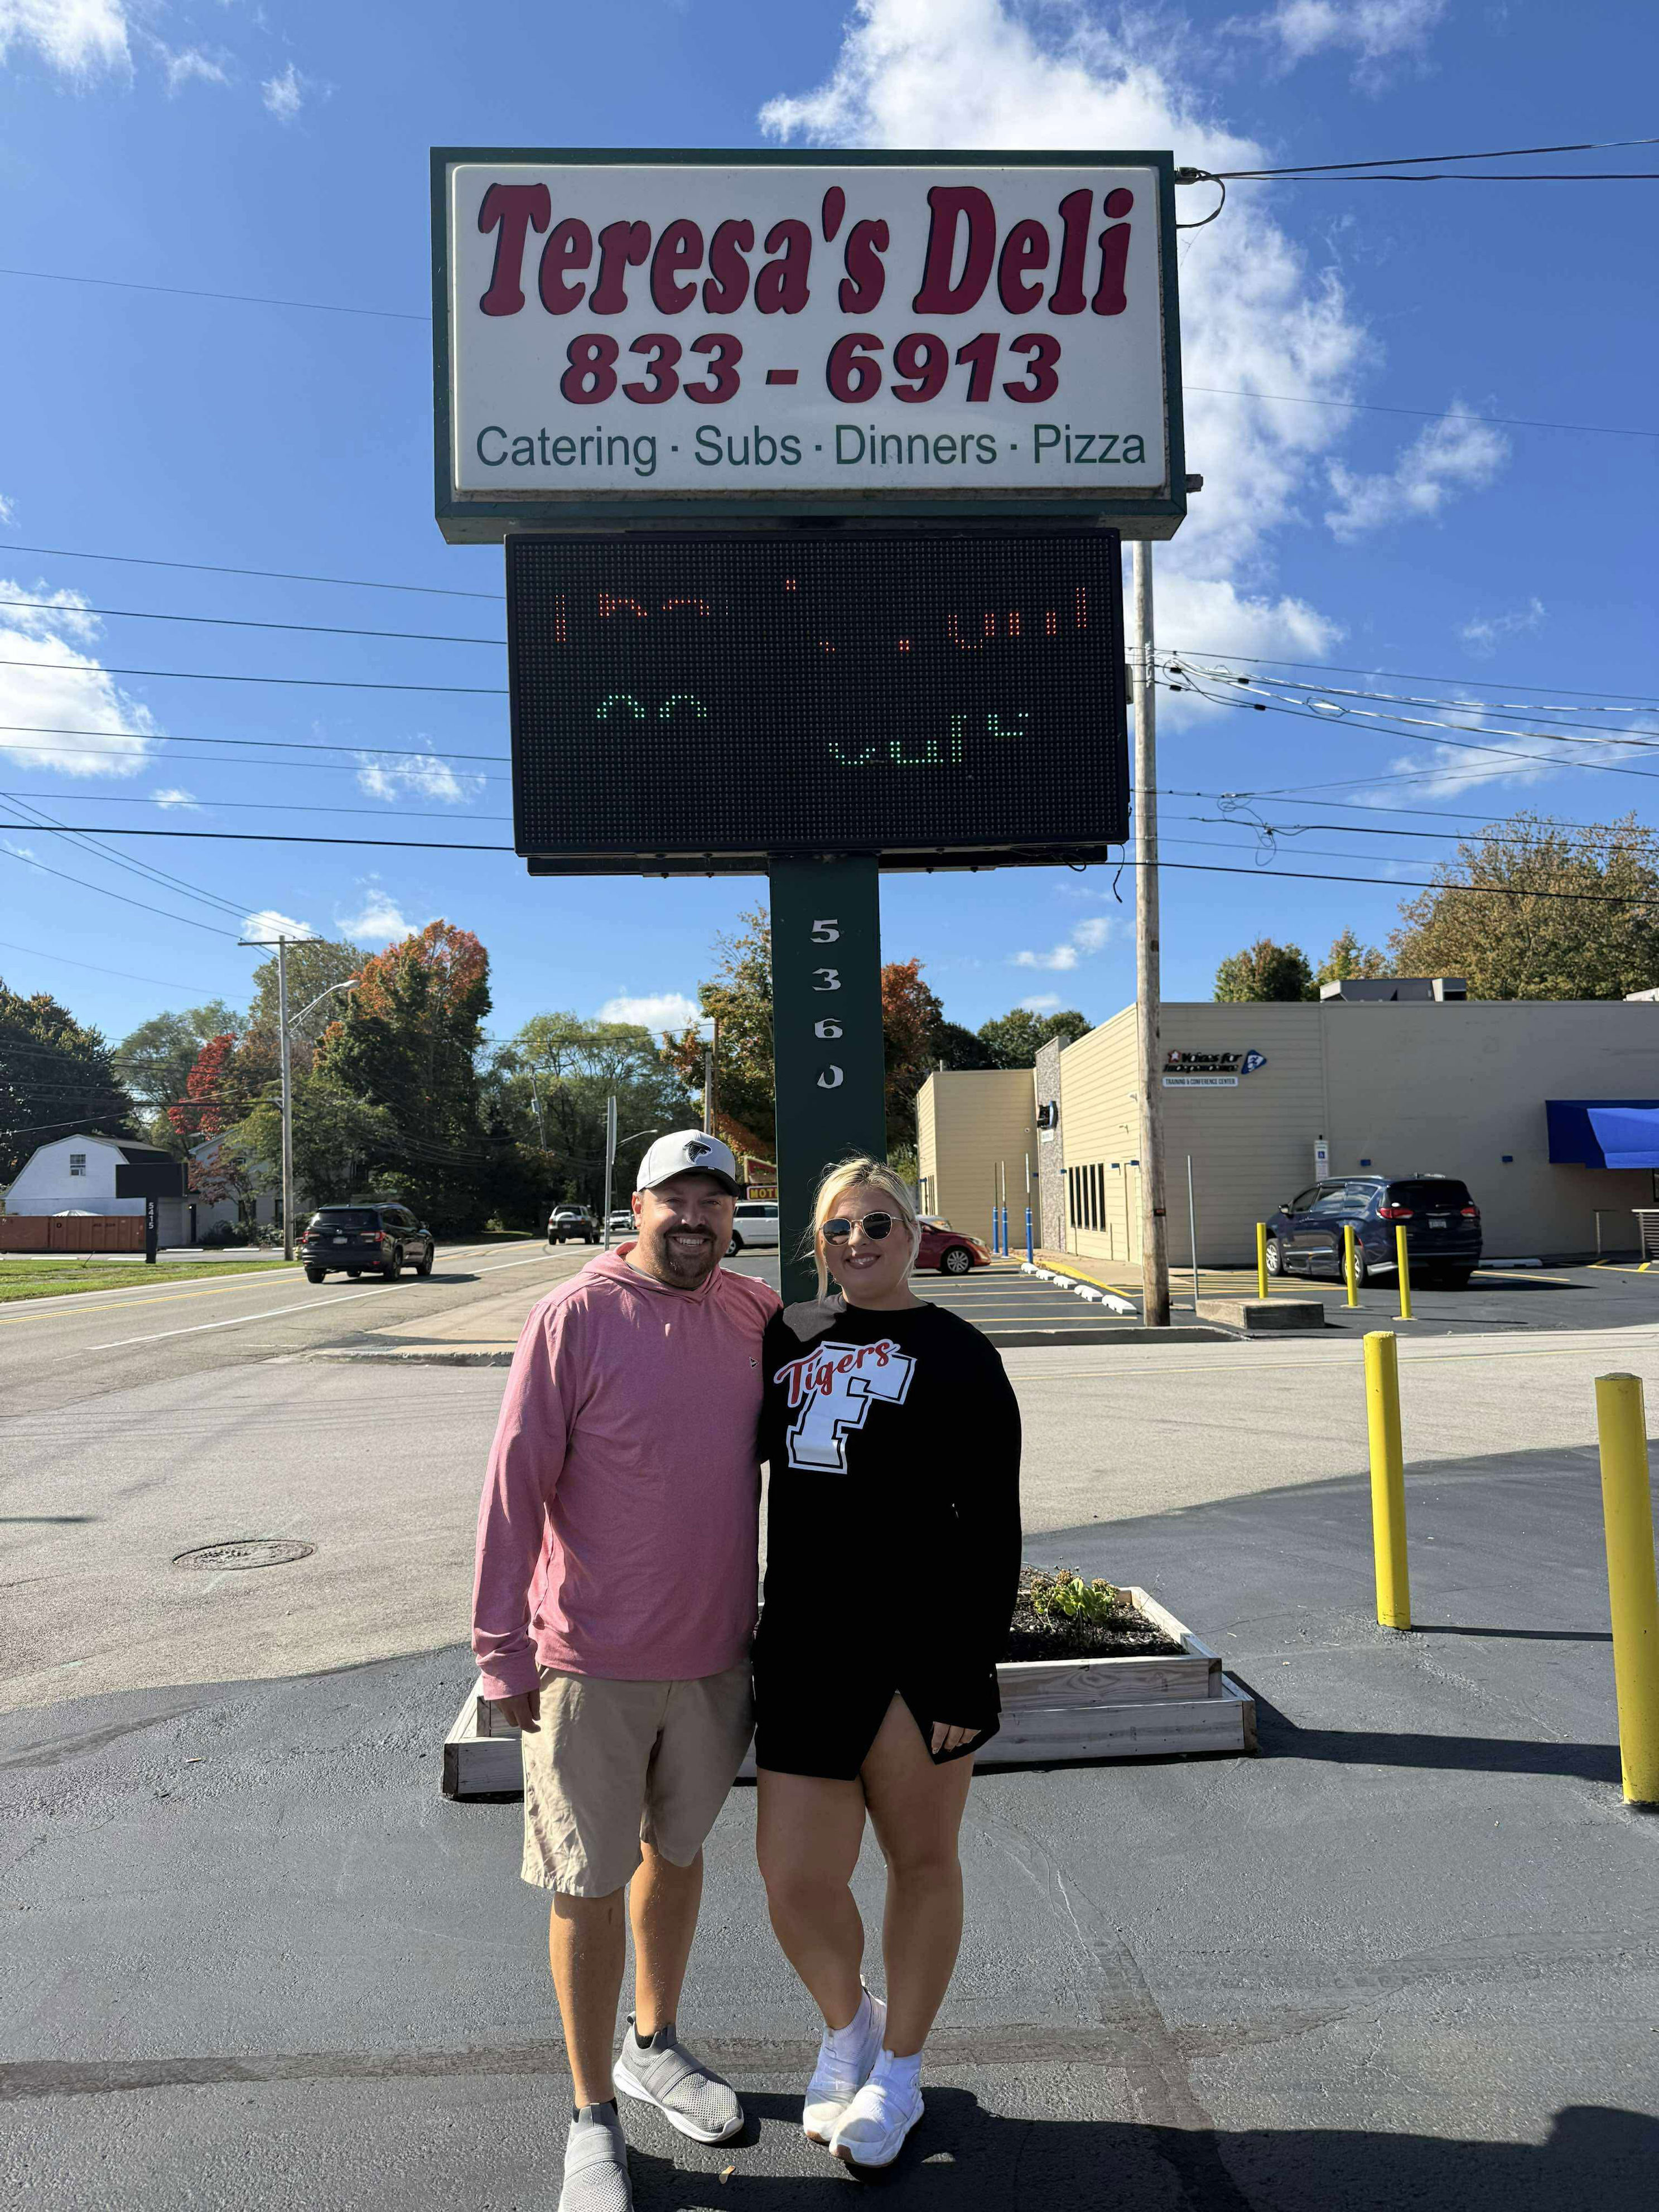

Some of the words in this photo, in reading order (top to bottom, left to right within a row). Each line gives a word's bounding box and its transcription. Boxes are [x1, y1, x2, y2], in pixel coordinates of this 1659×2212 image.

[478, 182, 890, 317] Teresa's
[912, 186, 1135, 316] Deli
[560, 333, 742, 404] 833
[826, 333, 1061, 403] 6913
[477, 426, 656, 476] Catering
[695, 425, 802, 466] Subs
[836, 424, 997, 465] Dinners
[1034, 424, 1146, 464] Pizza
[775, 1340, 899, 1406] Tigers
